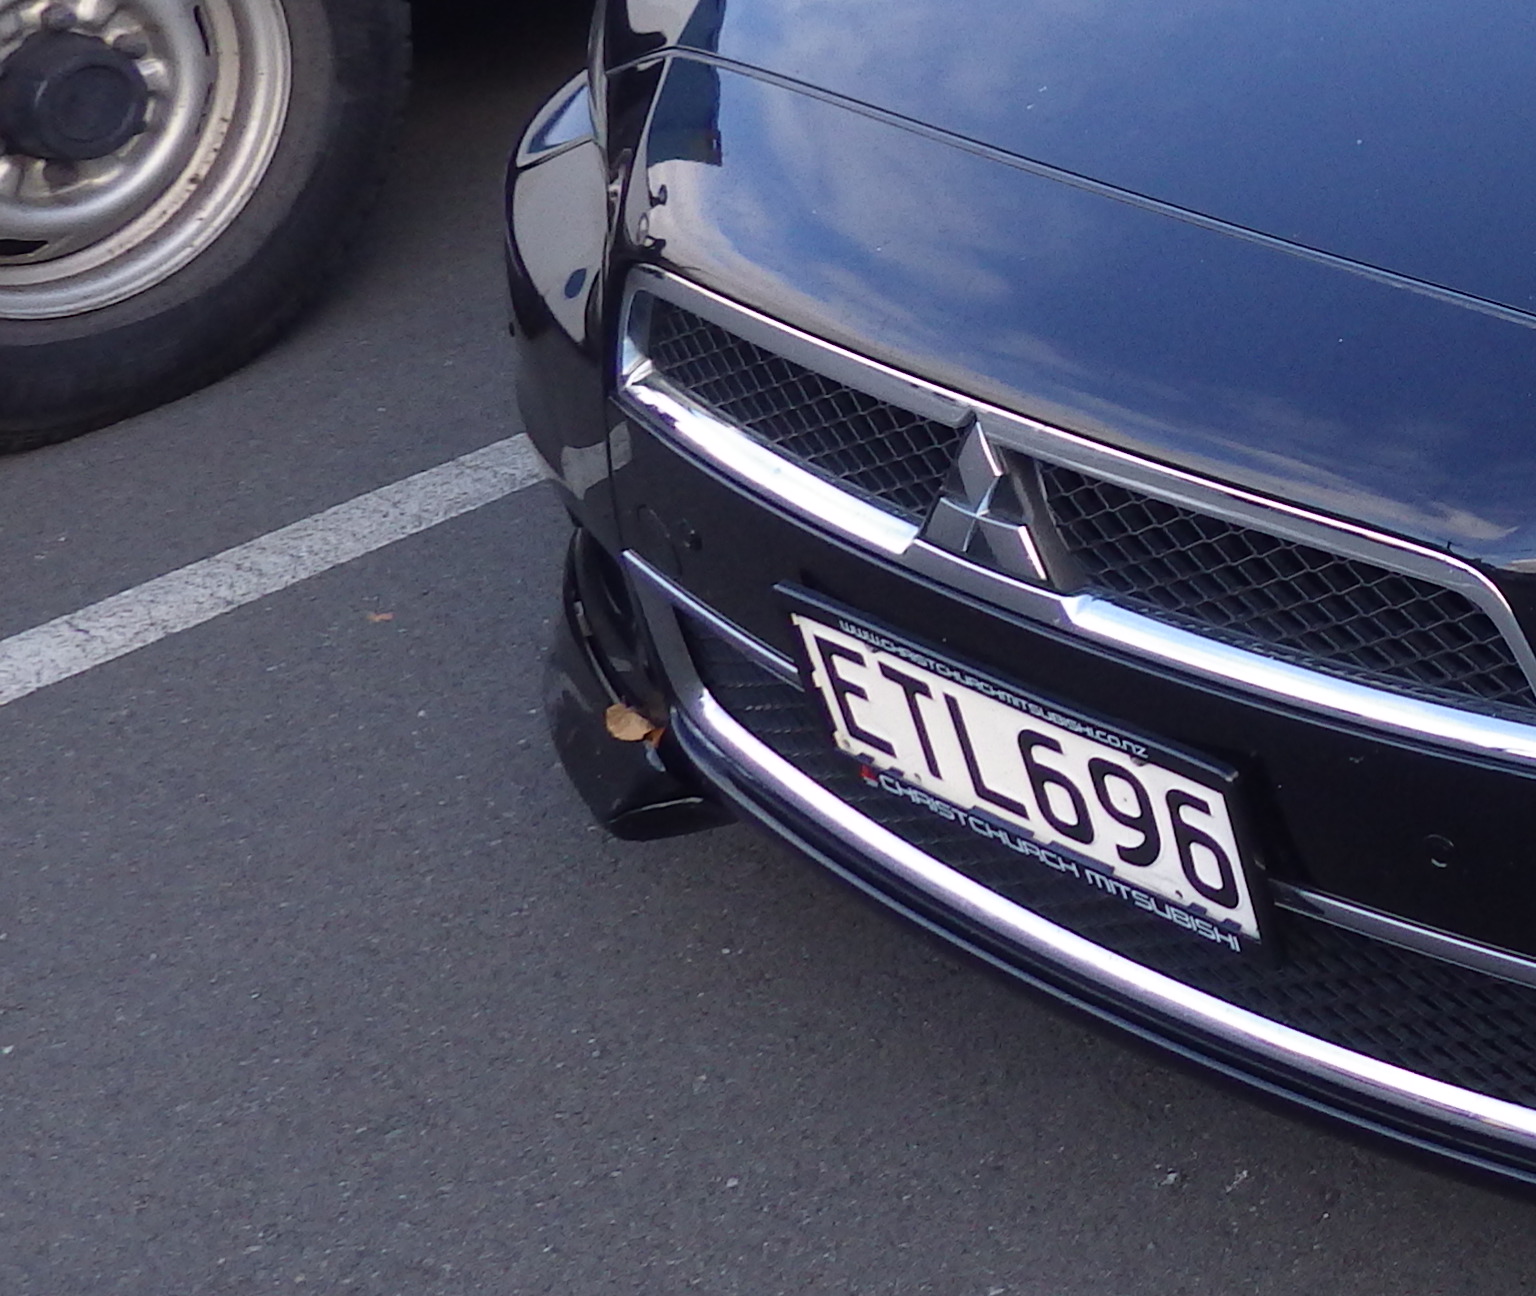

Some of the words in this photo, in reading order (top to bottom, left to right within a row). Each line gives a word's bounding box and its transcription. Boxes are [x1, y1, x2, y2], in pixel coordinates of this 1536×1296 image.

[816, 636, 1239, 909] ETL696
[878, 773, 1080, 879] CHRISTCHURCH
[1087, 869, 1242, 953] MITSUBISHI
